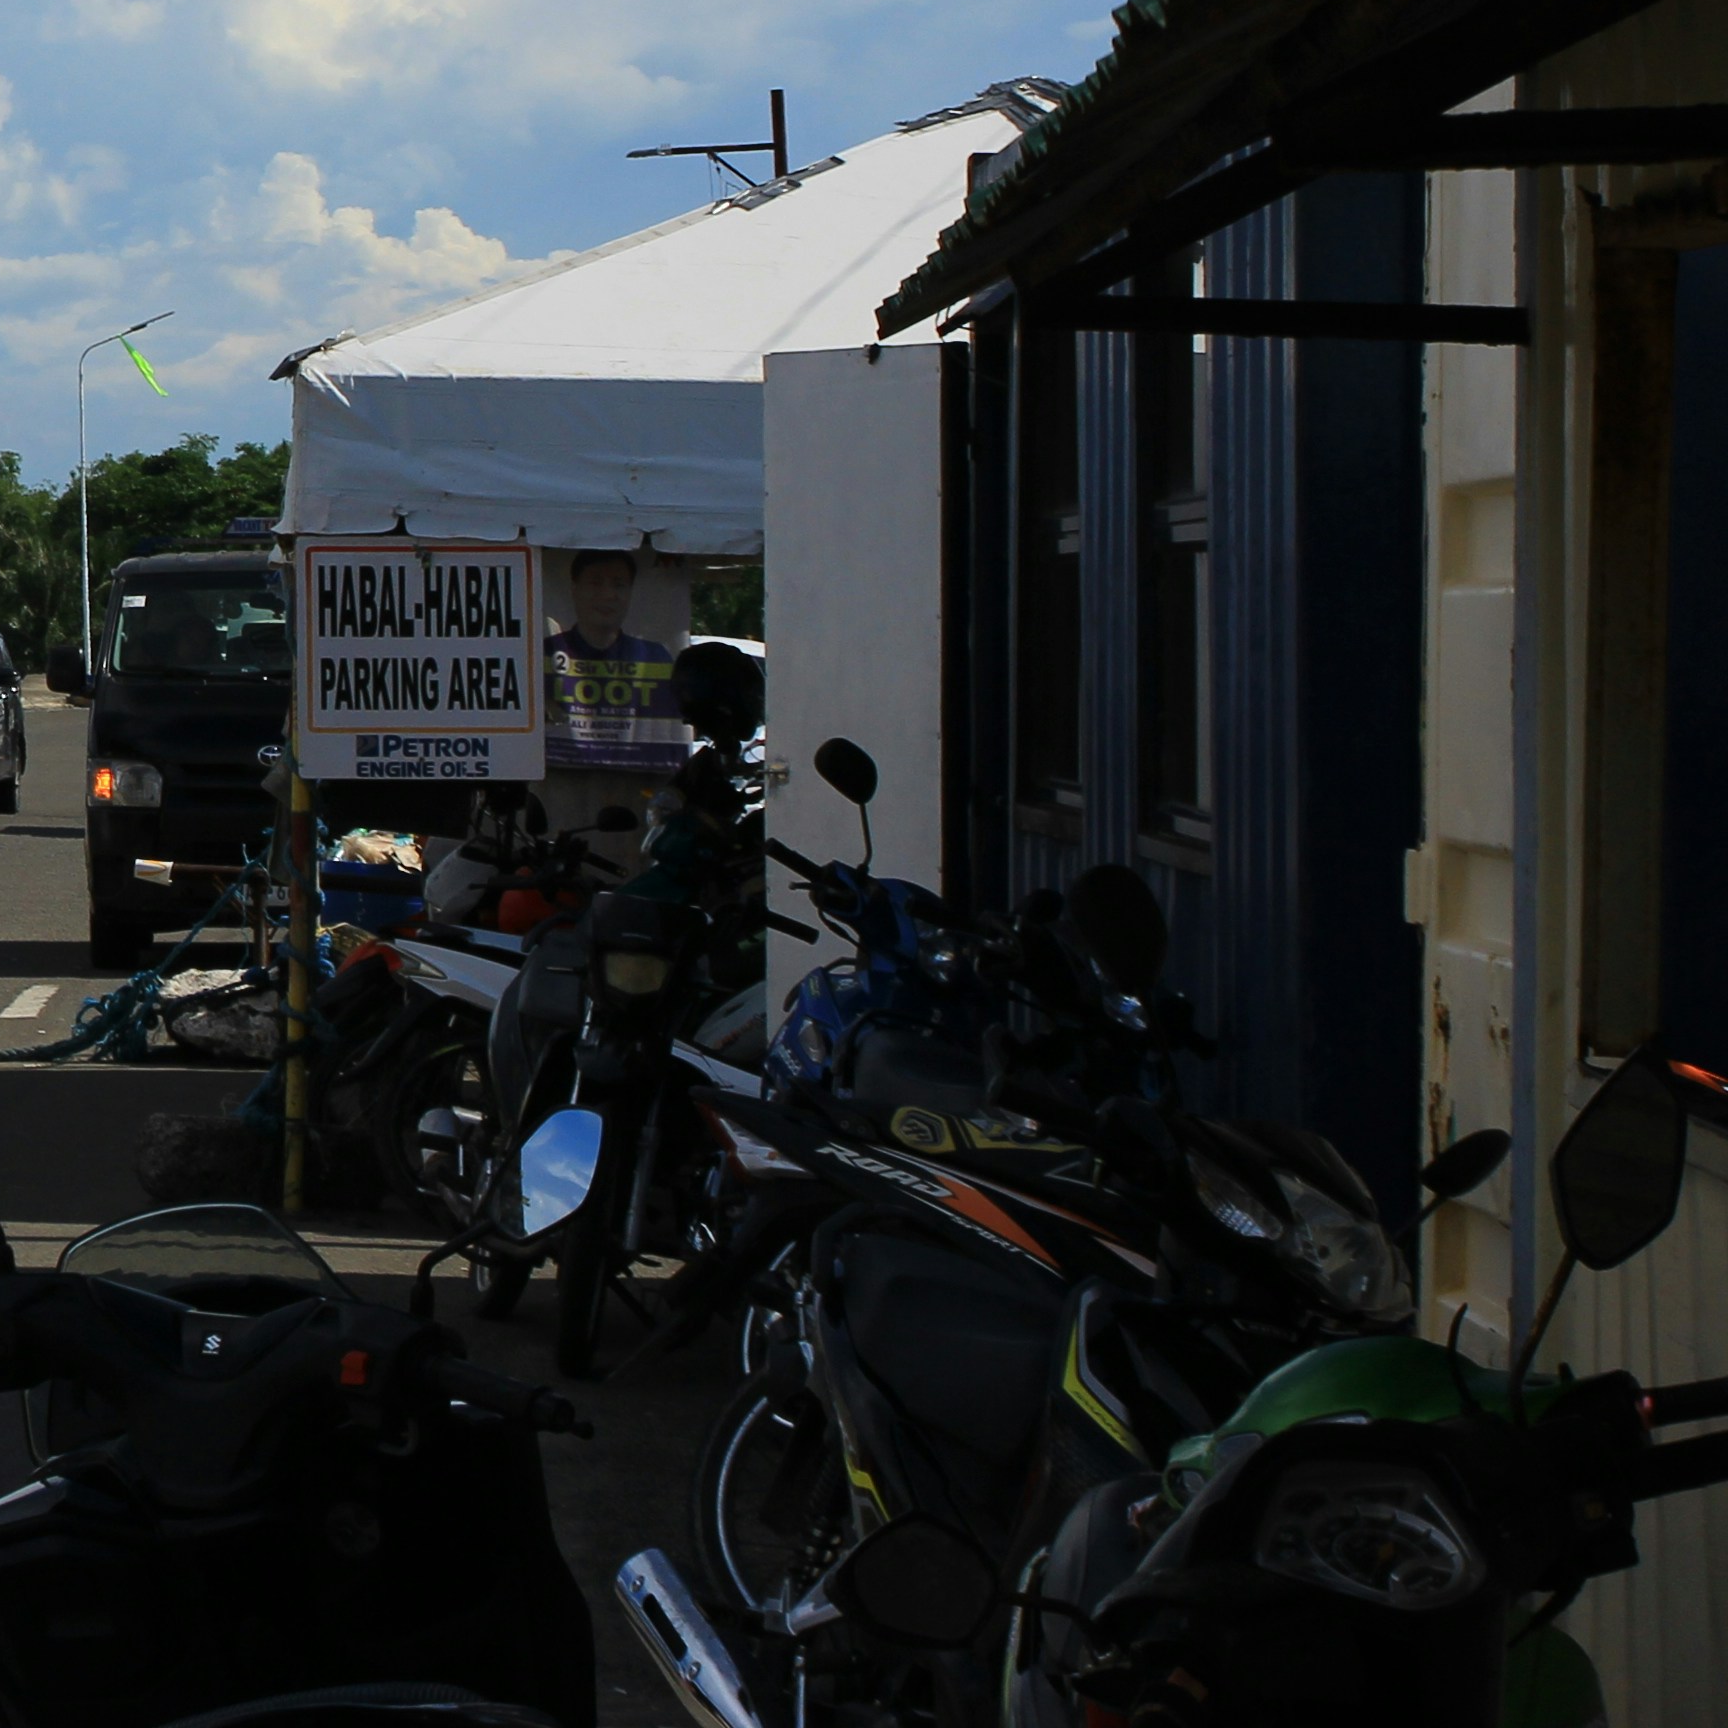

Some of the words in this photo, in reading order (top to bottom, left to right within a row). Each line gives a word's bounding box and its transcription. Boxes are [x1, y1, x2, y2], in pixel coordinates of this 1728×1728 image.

[318, 565, 521, 638] HABAL-HABAL
[320, 657, 440, 711] PARKING
[447, 657, 521, 711] AREA
[553, 679, 658, 706] LOOT
[383, 735, 489, 757] PETRON
[356, 761, 435, 777] ENGINE
